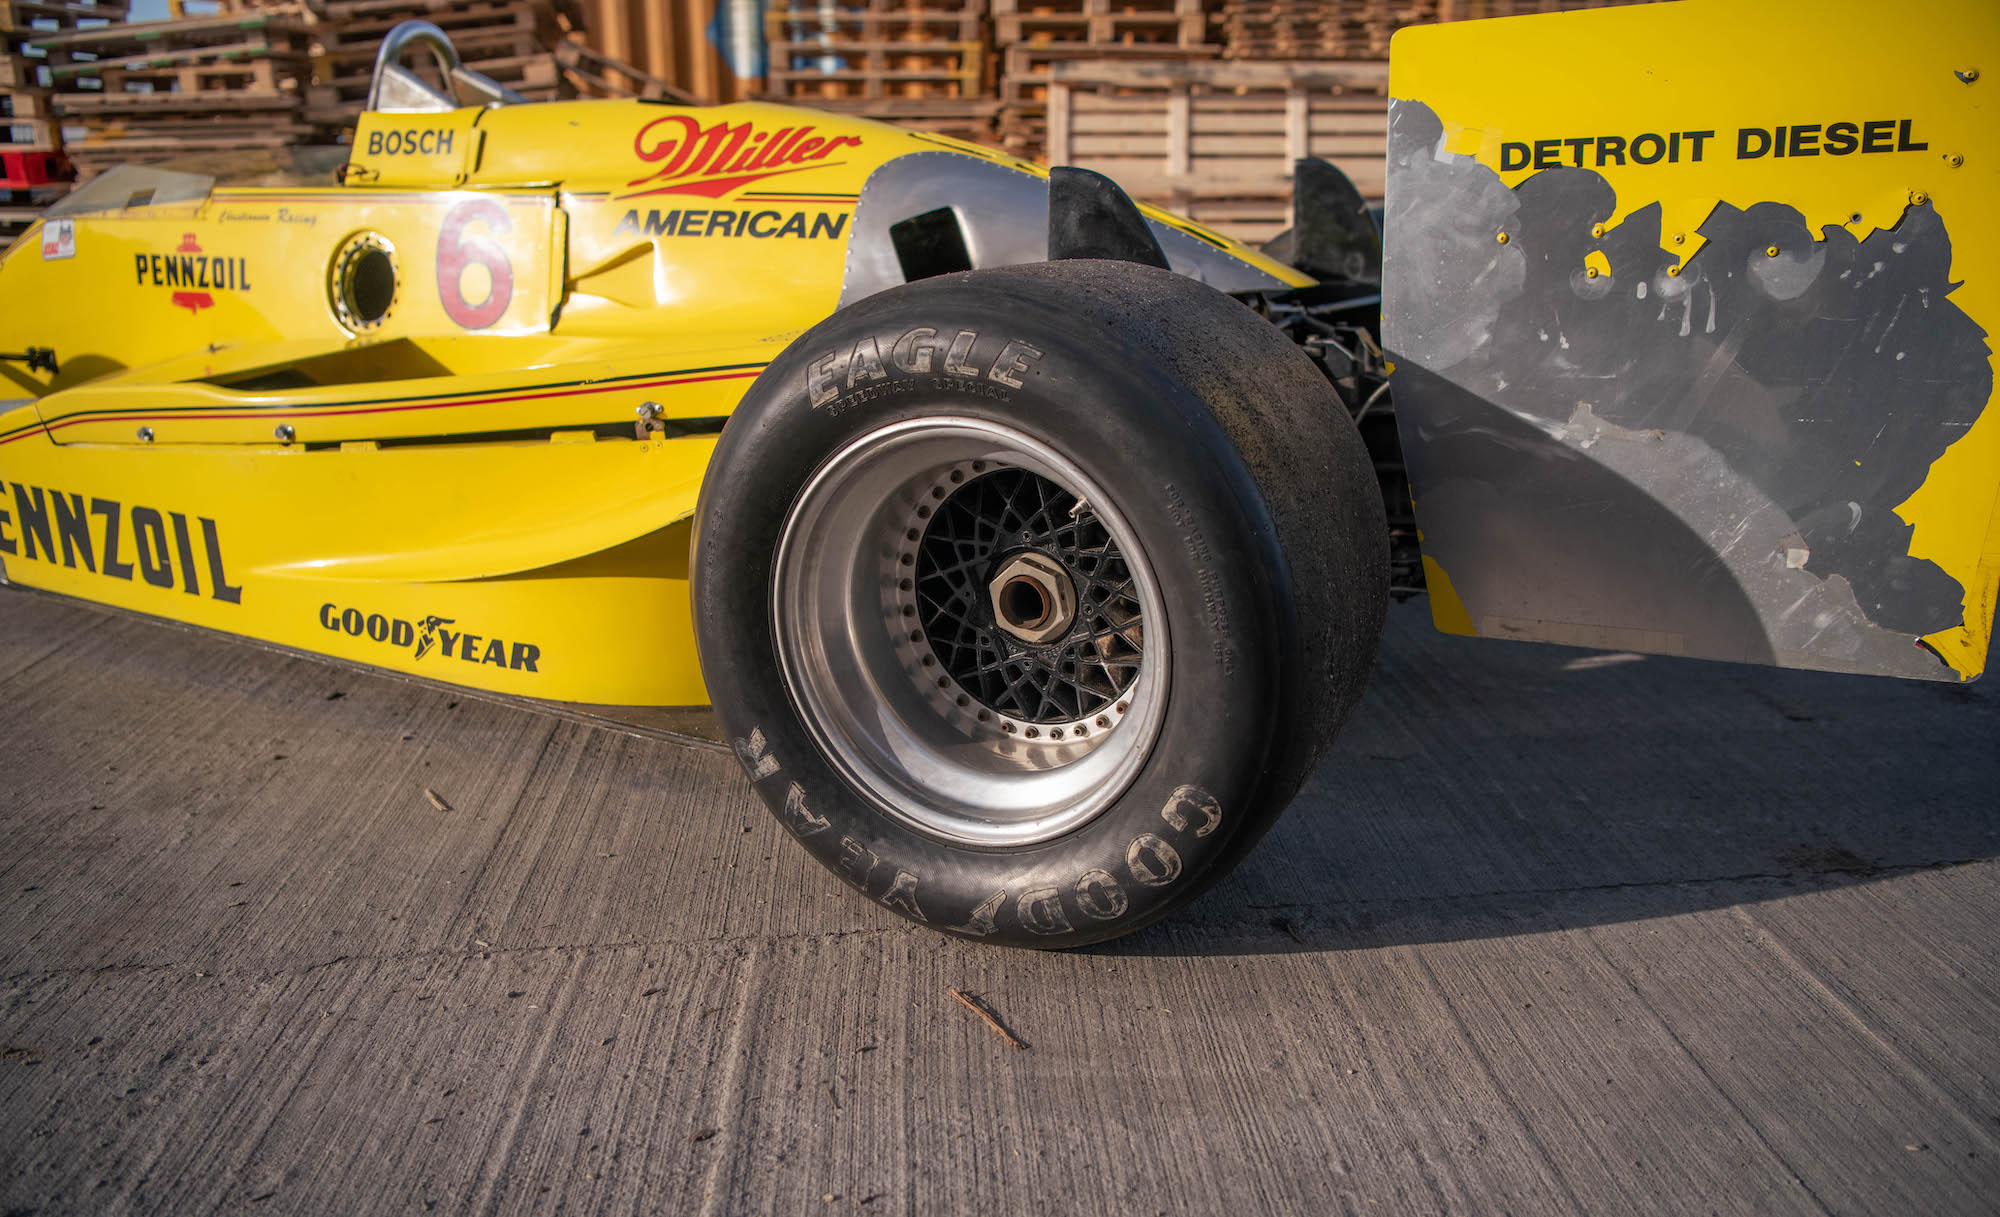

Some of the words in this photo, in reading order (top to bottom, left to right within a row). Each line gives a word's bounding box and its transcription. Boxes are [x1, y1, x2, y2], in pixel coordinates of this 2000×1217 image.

[367, 128, 455, 156] BOSCH
[627, 114, 862, 188] Miller
[1500, 130, 1715, 172] DETROIT
[1736, 119, 1929, 160] DIESEL
[613, 208, 849, 239] AMERICAN
[134, 253, 251, 291] PENNZOIL
[435, 197, 515, 331] 6
[806, 327, 1045, 410] EAGLE
[825, 378, 917, 418] SPEEDWAY
[931, 376, 1014, 405] SPECIAL
[0, 480, 242, 605] ENNZOIL
